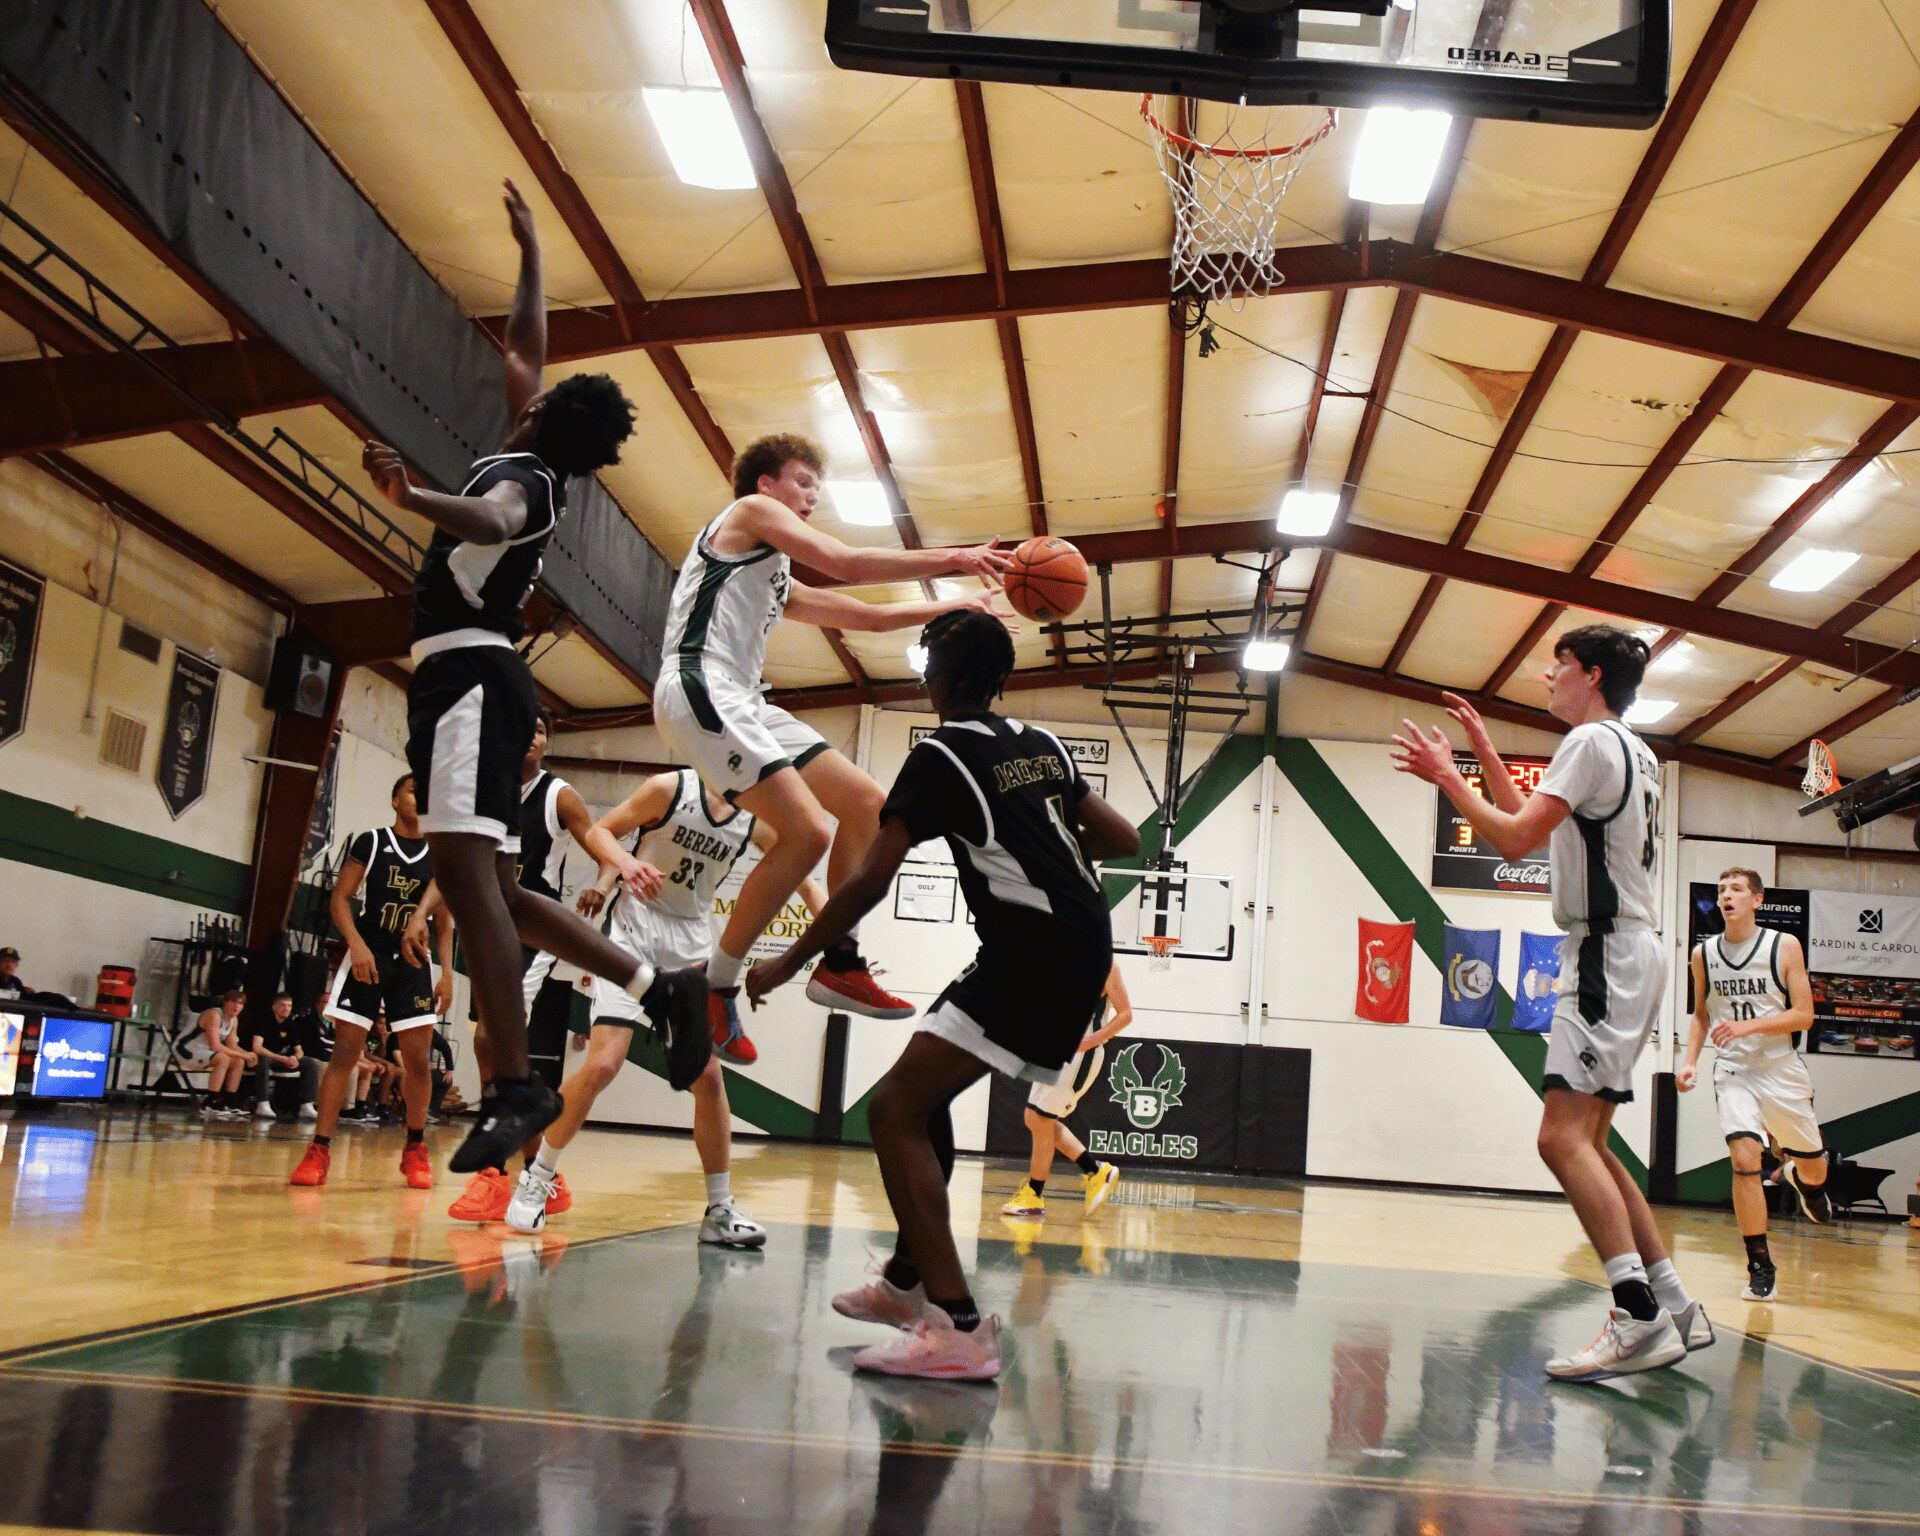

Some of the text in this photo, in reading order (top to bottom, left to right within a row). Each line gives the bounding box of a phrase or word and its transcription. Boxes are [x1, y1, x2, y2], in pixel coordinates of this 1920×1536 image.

[993, 756, 1065, 793] JACKETS
[1456, 763, 1482, 775] UEST
[1452, 817, 1470, 825] FOU
[672, 824, 734, 863] BEREAN
[1458, 826, 1472, 846] 3
[1448, 845, 1478, 854] POINTS
[1757, 903, 1802, 913] surance
[1812, 938, 1856, 950] RARDIN
[1860, 941, 1867, 951] &
[1713, 977, 1768, 997] BEREAN
[1730, 1001, 1756, 1022] 10
[1133, 1094, 1159, 1117] B
[1088, 1129, 1198, 1160] EAGLES
